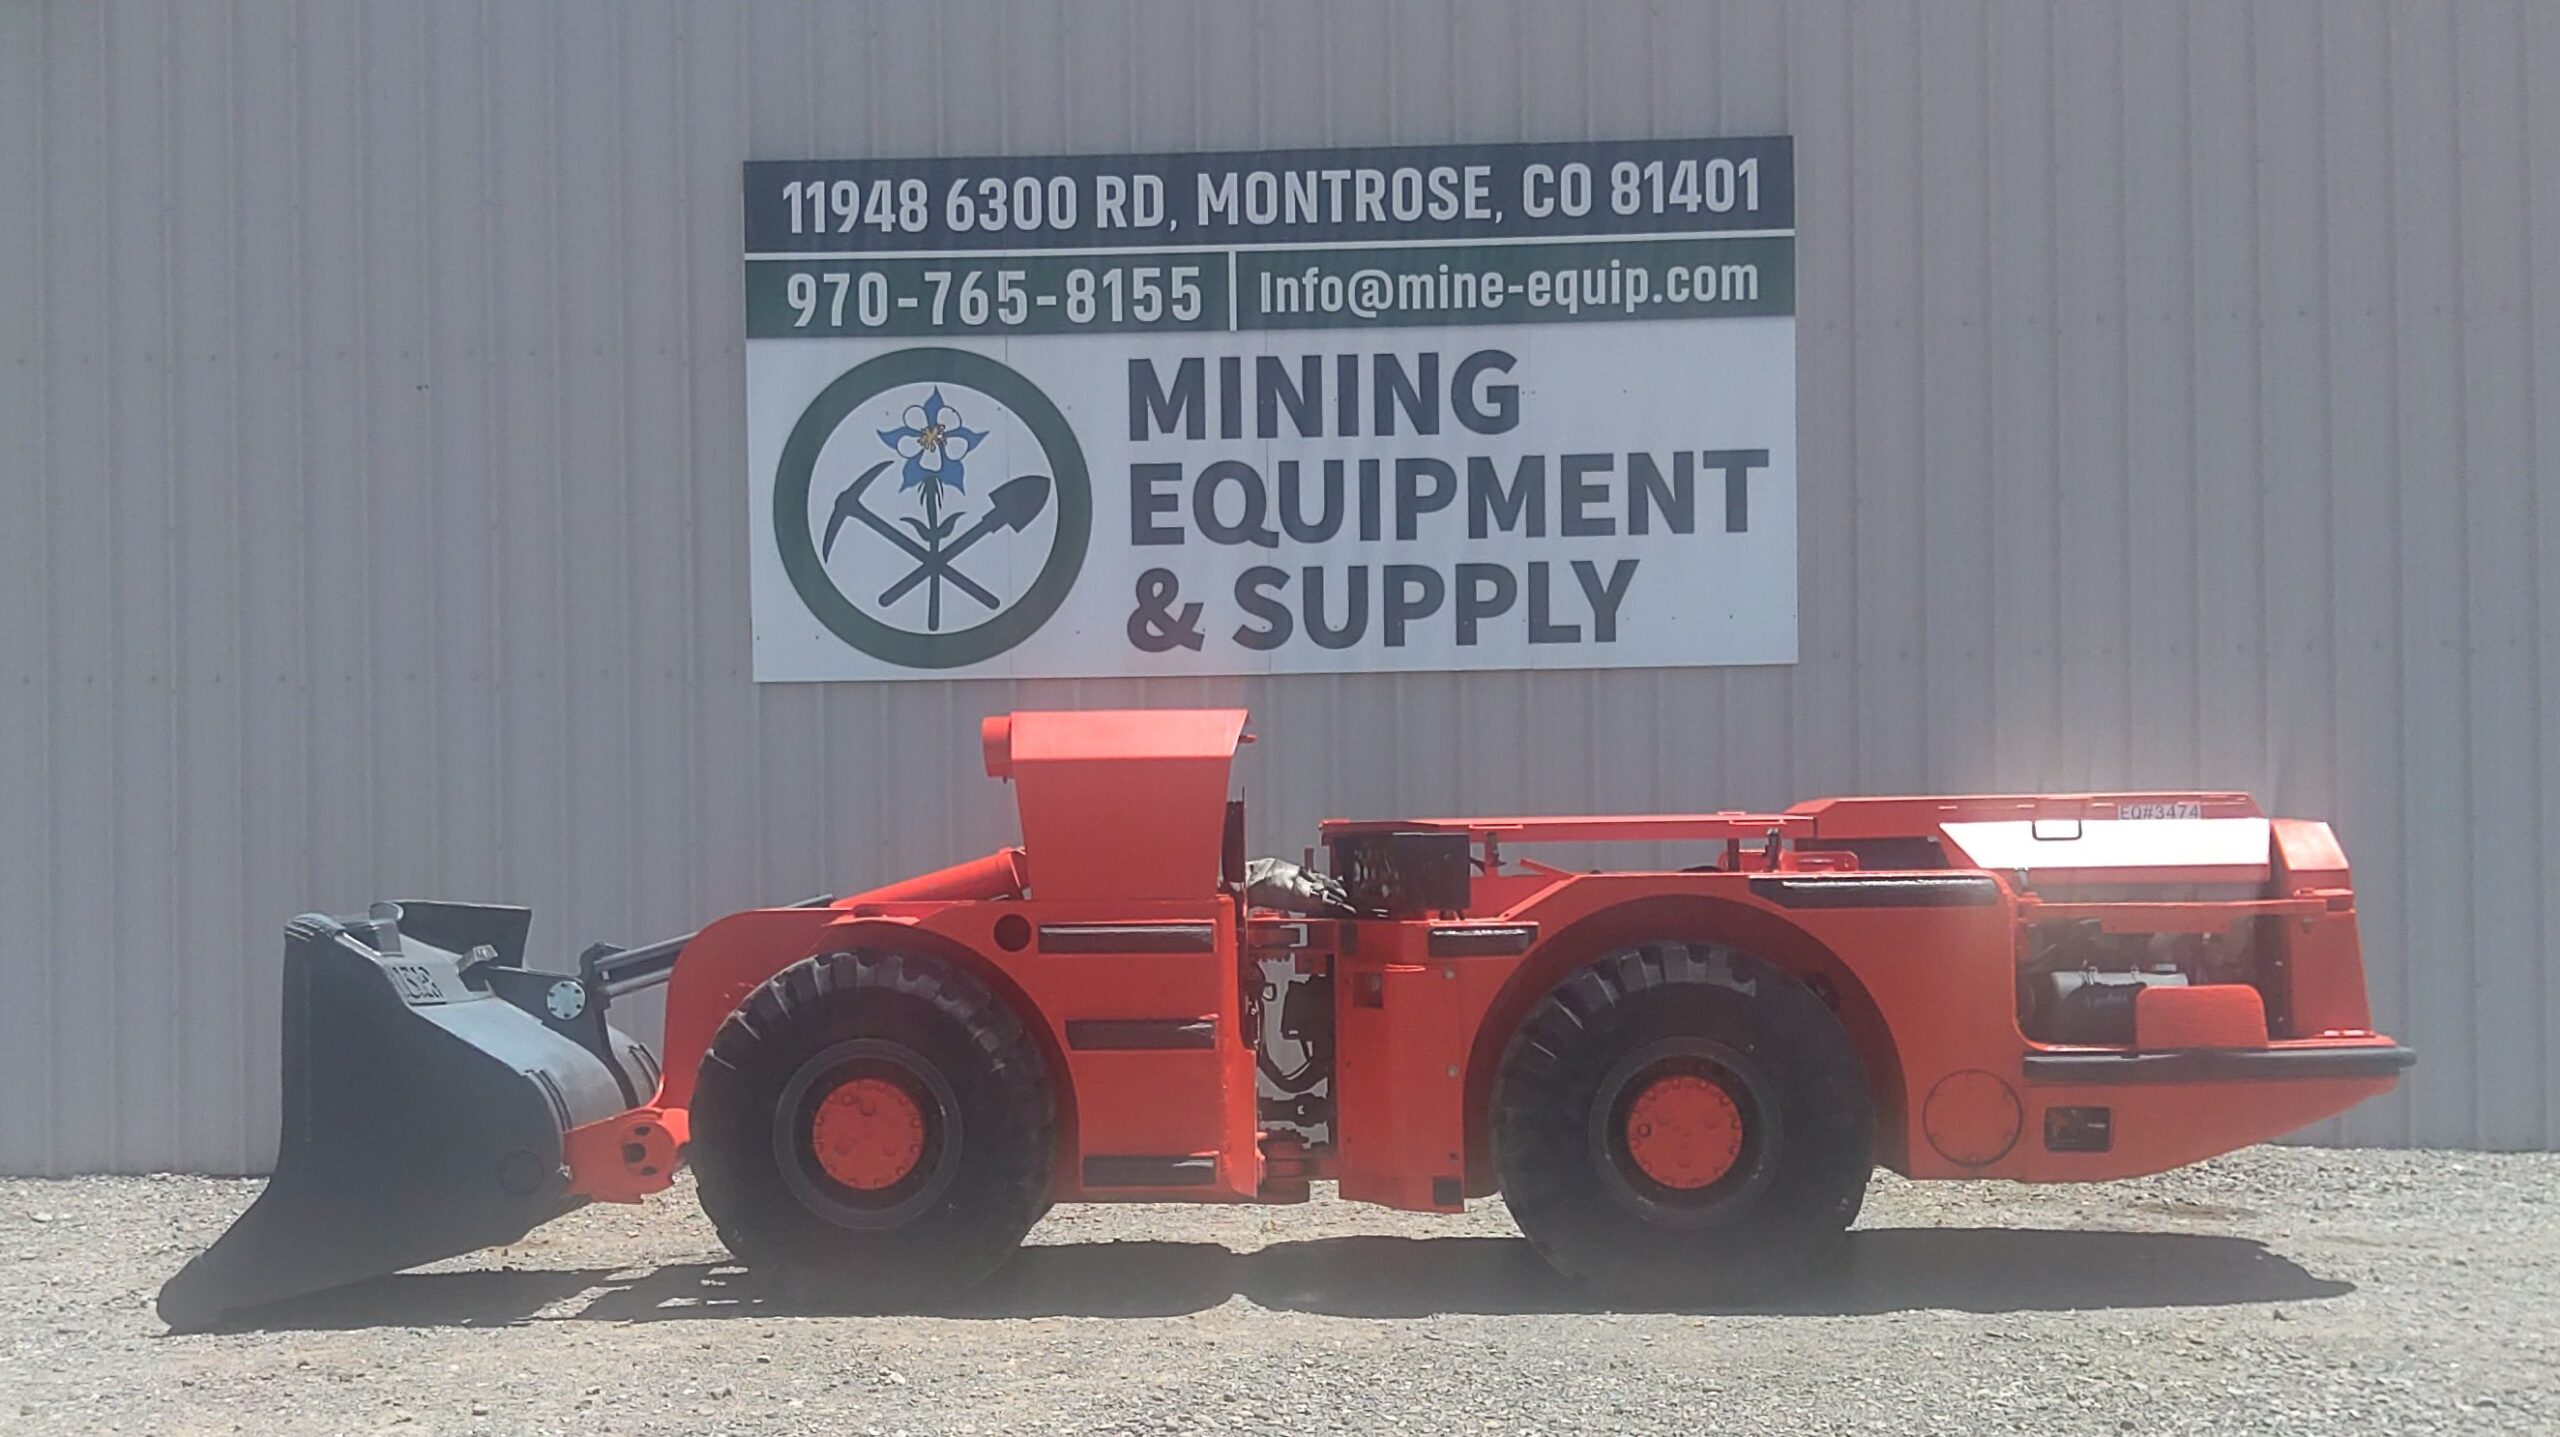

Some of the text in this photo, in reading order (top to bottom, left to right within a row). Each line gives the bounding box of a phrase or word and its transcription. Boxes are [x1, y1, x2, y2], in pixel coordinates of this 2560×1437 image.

[783, 157, 1760, 234] 11948 6300 RD, MONTROSE, CO 81401
[786, 266, 1202, 328] 970-765-8155
[1260, 259, 1759, 319] Info@mine-equip.com
[1127, 349, 1521, 442] MINING
[1129, 448, 1770, 549] EQUIPMENT
[1126, 559, 1641, 653] & SUPPLY
[2120, 804, 2199, 820] EQ#3474
